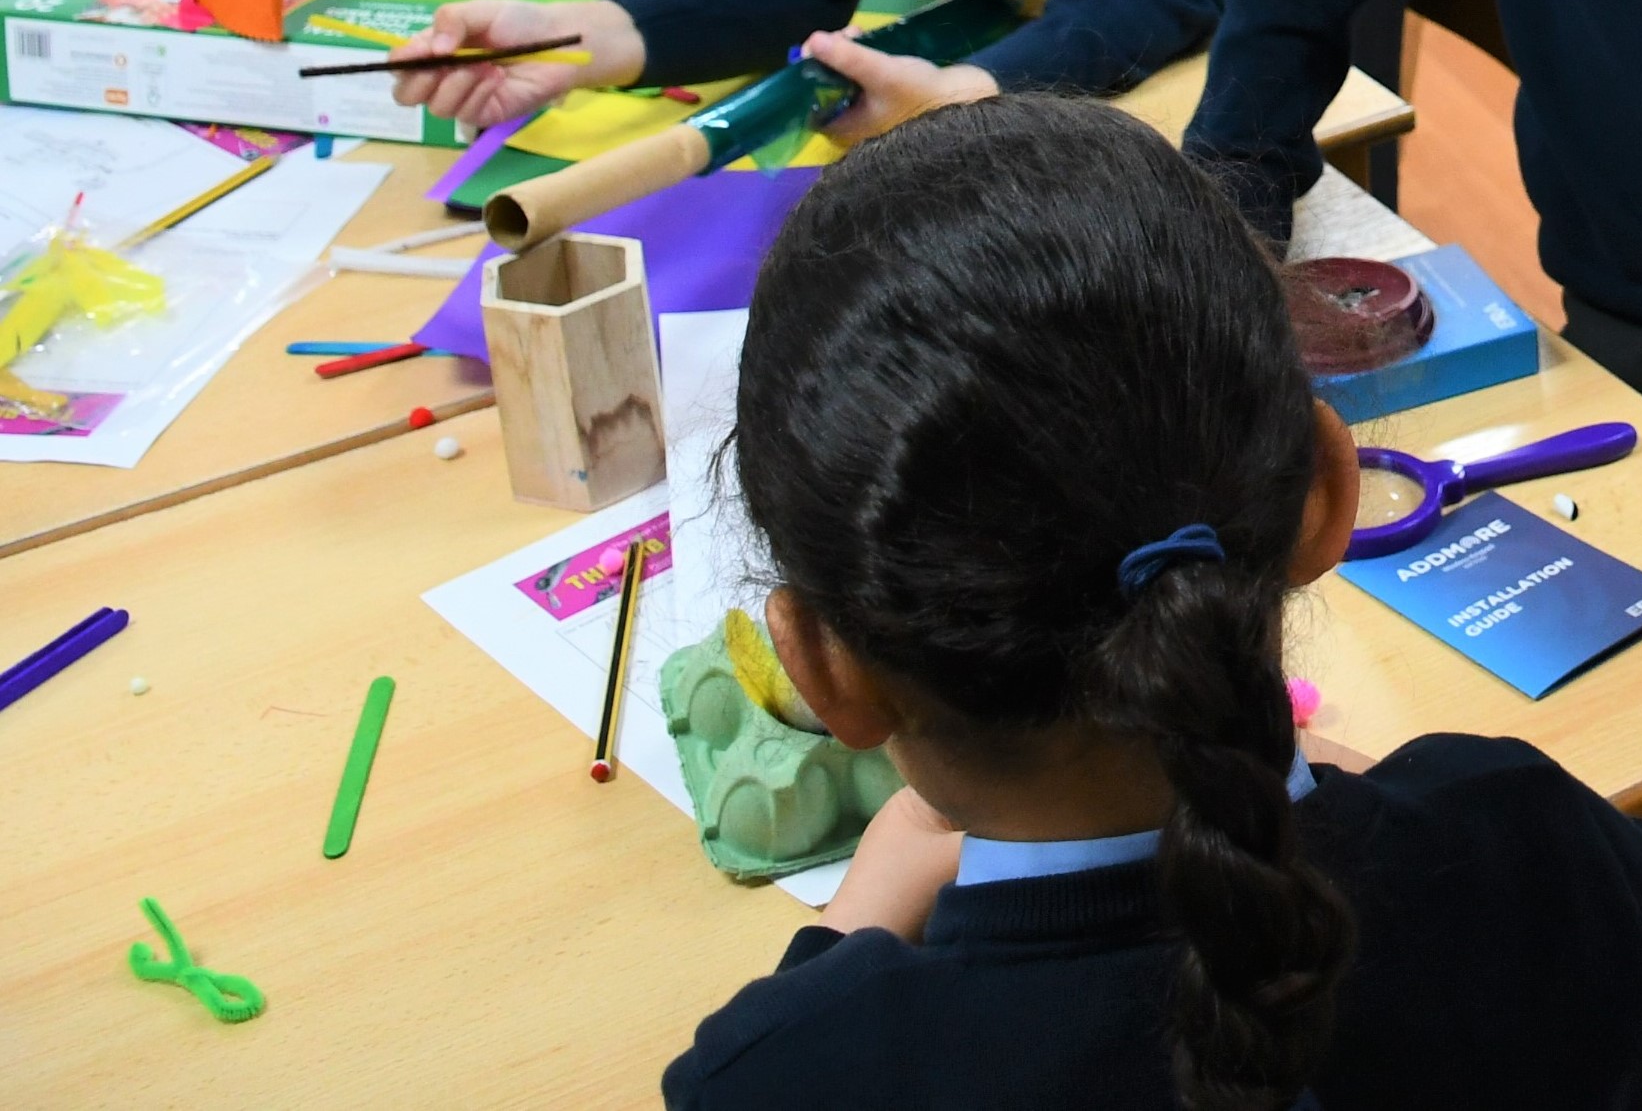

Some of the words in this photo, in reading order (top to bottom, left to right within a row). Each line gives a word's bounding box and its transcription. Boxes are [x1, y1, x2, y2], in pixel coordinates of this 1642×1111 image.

[1396, 518, 1511, 582] ADDMORE
[1448, 557, 1574, 627] INSTALLATION
[1465, 602, 1522, 637] GUIDE
